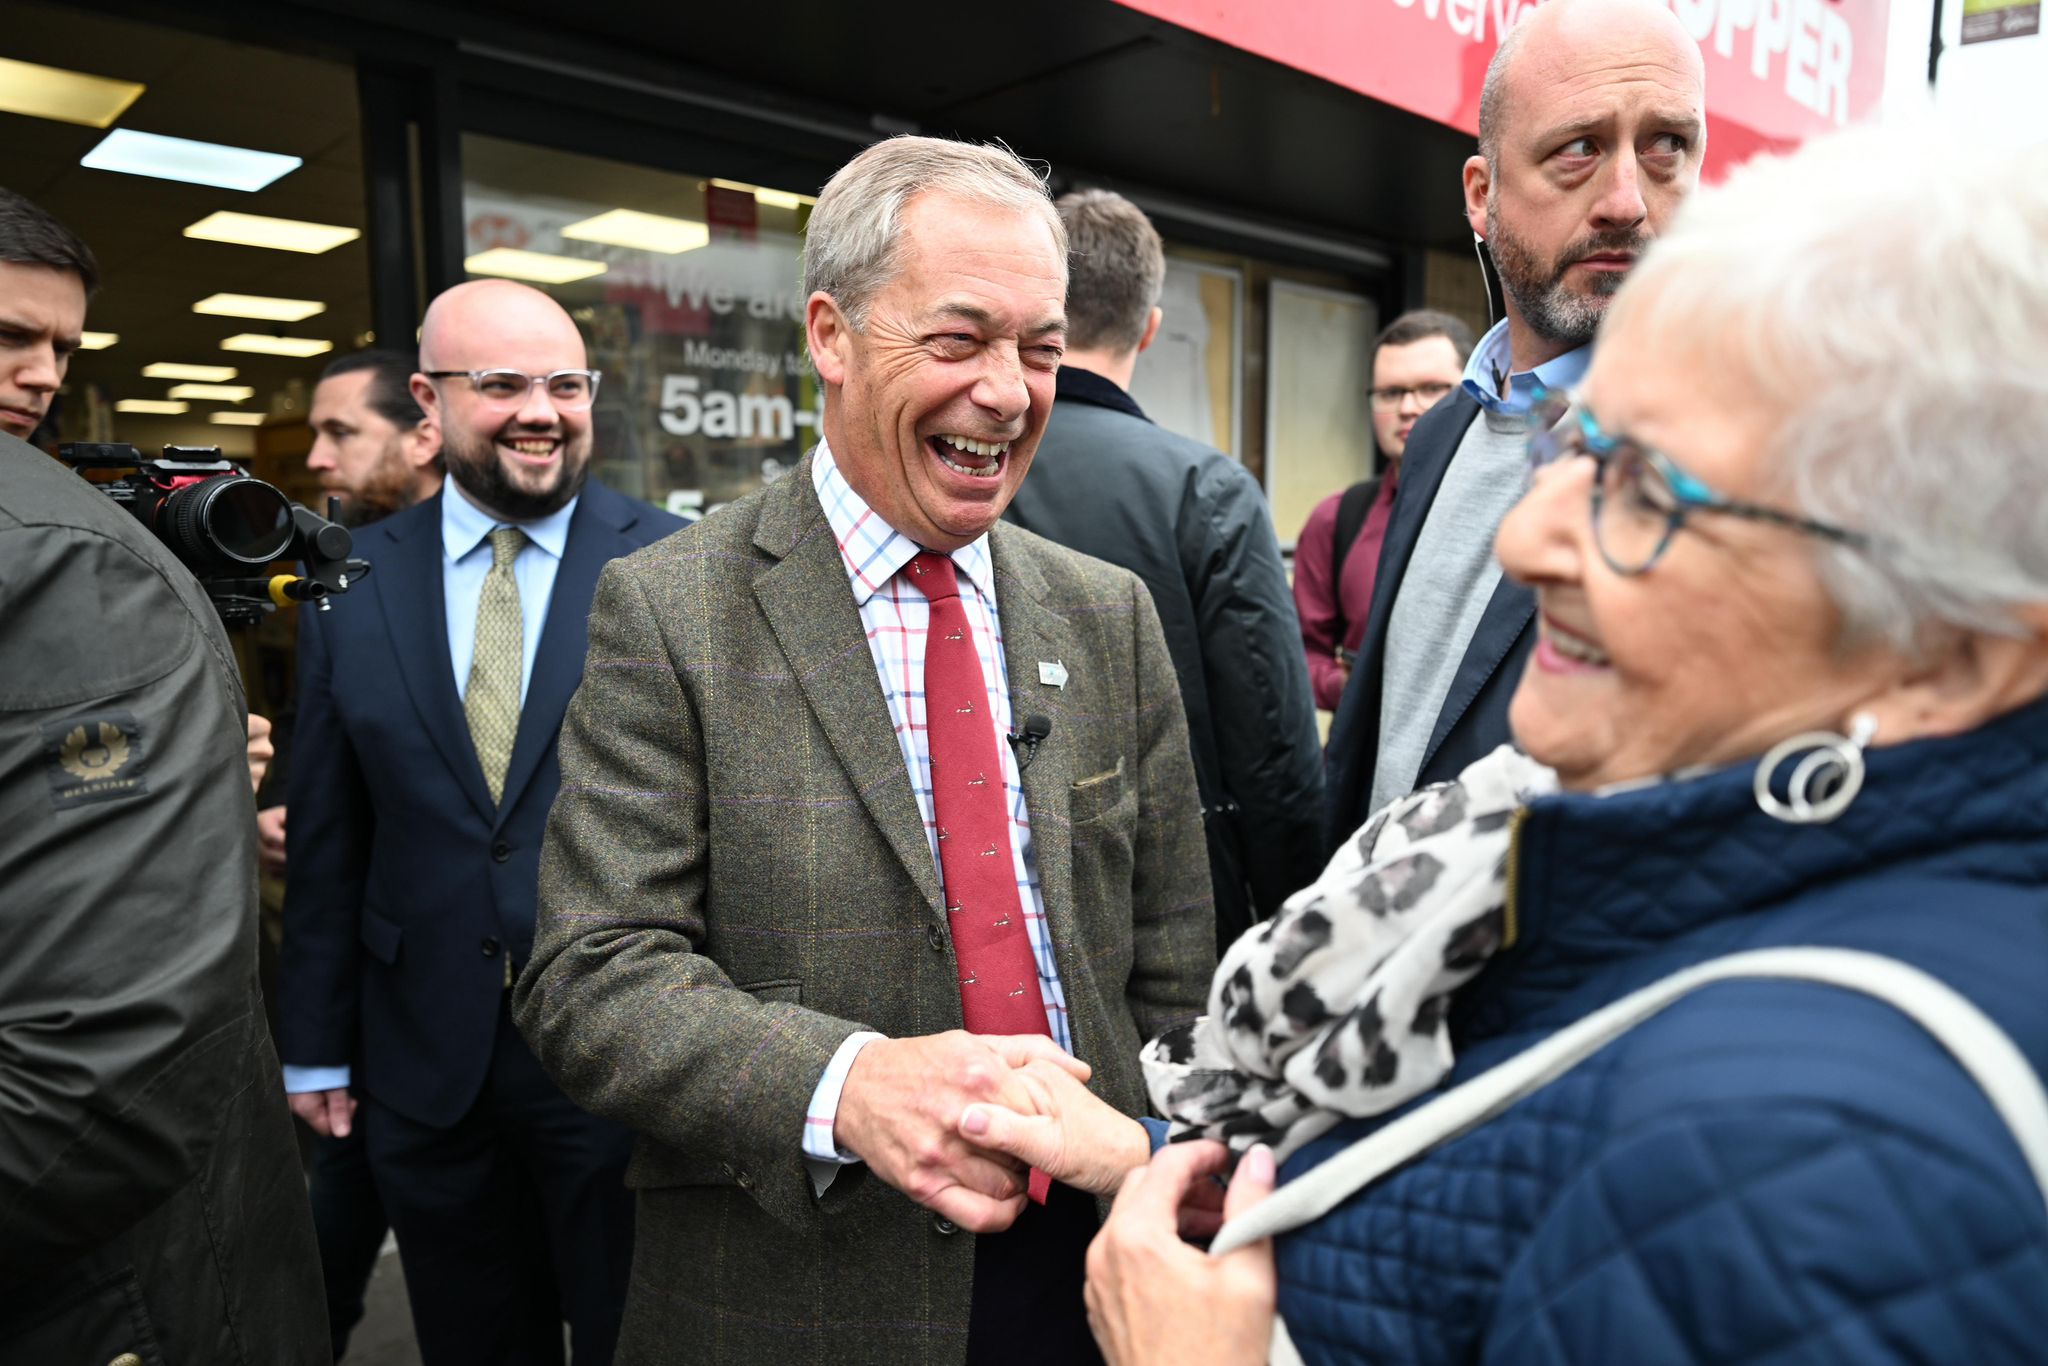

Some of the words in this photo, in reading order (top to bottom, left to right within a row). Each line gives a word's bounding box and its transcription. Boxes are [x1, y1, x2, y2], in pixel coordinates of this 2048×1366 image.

[661, 264, 737, 316] We
[684, 338, 782, 379] Monday
[659, 374, 824, 441] 5am-
